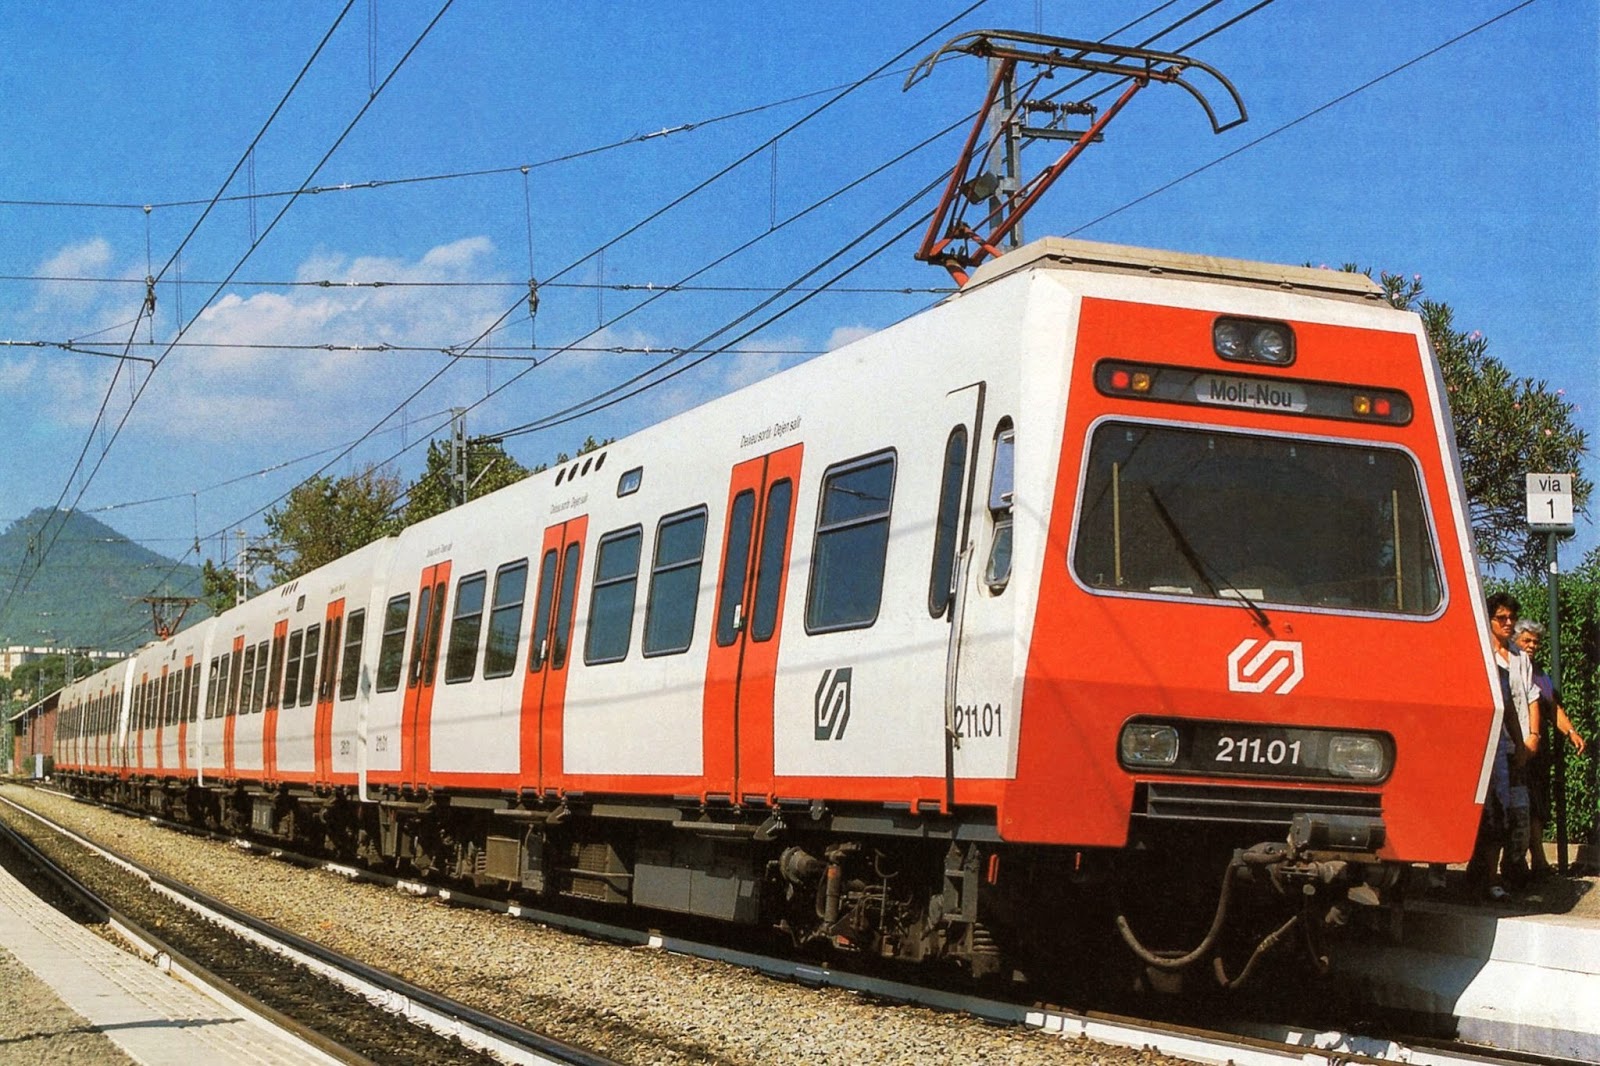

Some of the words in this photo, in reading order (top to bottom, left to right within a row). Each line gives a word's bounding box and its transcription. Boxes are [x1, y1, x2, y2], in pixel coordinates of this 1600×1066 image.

[1539, 475, 1561, 492] via
[1546, 498, 1554, 519] 1
[955, 703, 1001, 738] 211.01
[1215, 737, 1301, 764] 211.01
